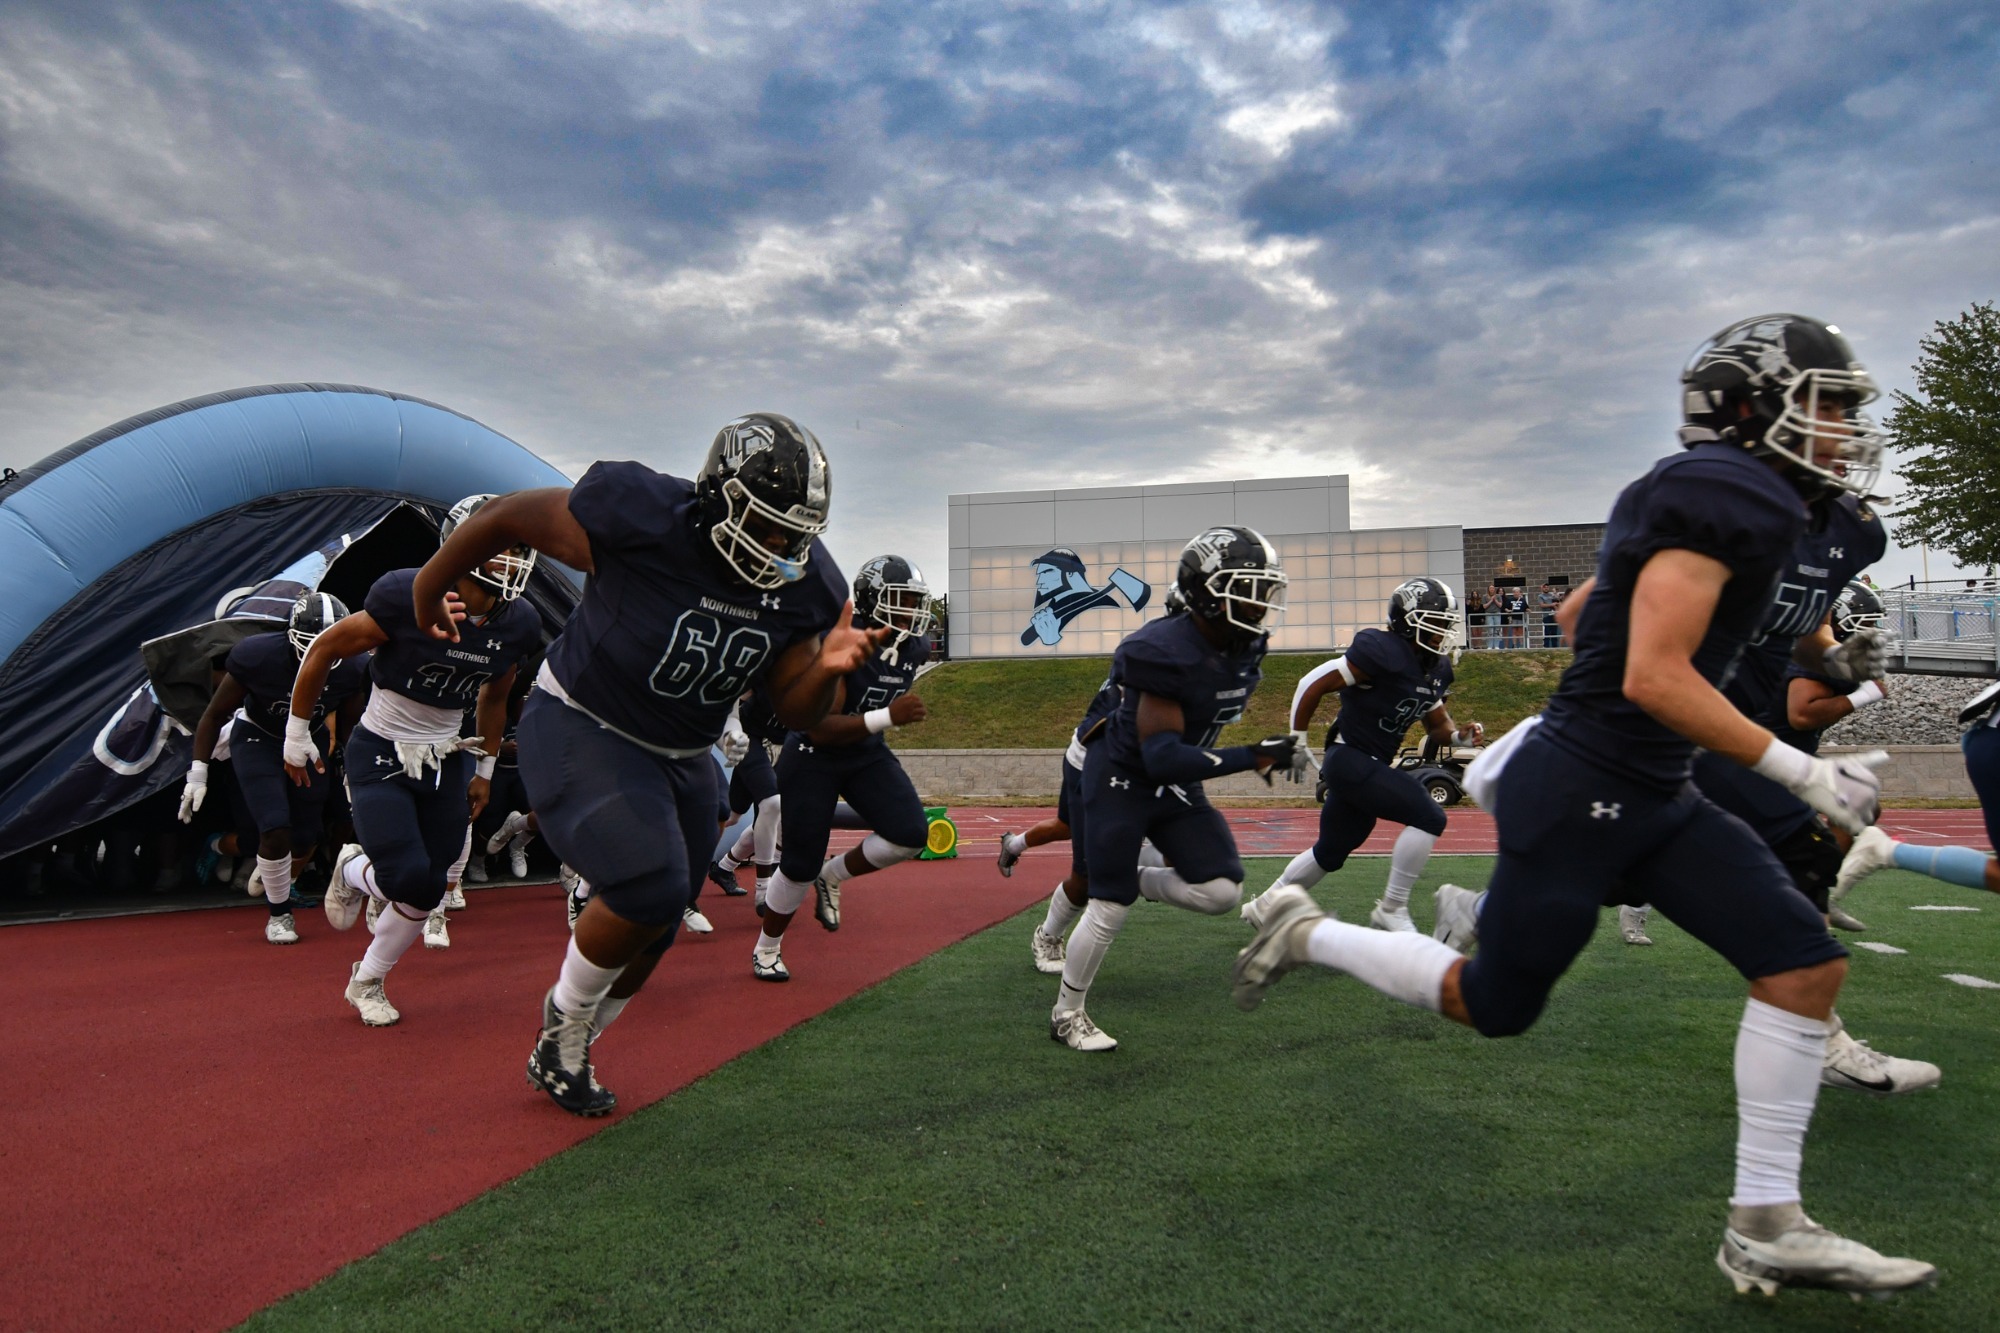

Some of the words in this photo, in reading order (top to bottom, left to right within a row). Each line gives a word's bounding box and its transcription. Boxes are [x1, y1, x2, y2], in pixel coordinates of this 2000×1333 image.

[700, 596, 760, 620] NORTHMEN
[446, 649, 491, 664] NORTHMEN
[648, 608, 771, 705] 68
